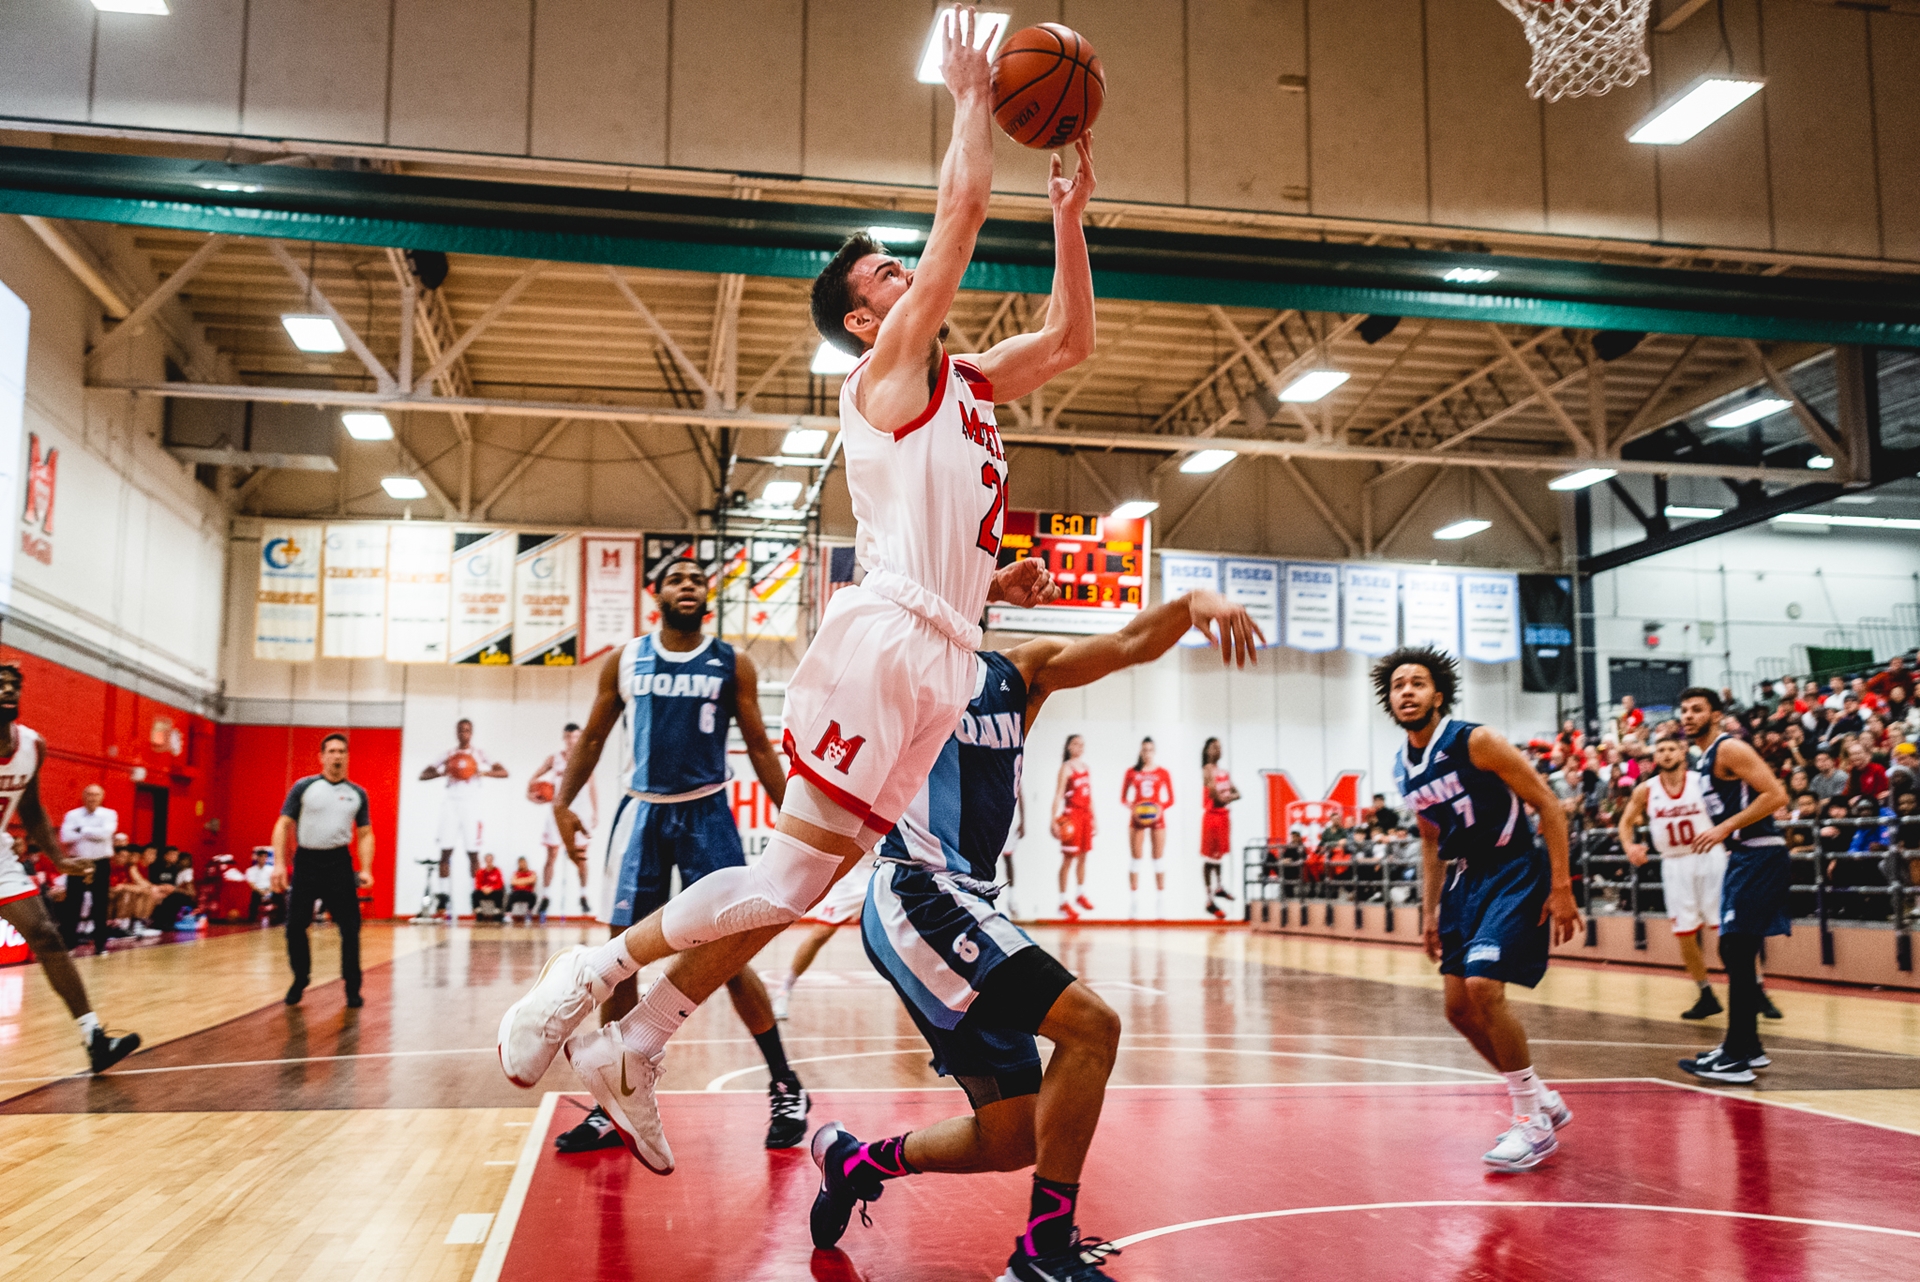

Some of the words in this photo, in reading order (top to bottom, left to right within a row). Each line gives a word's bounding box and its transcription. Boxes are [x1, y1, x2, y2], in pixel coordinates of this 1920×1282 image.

[1051, 514, 1097, 536] 6:01
[633, 672, 724, 700] UQAM
[699, 702, 717, 733] 6
[955, 709, 1024, 749] QAM
[1452, 794, 1476, 828] 7
[1666, 820, 1696, 847] 10
